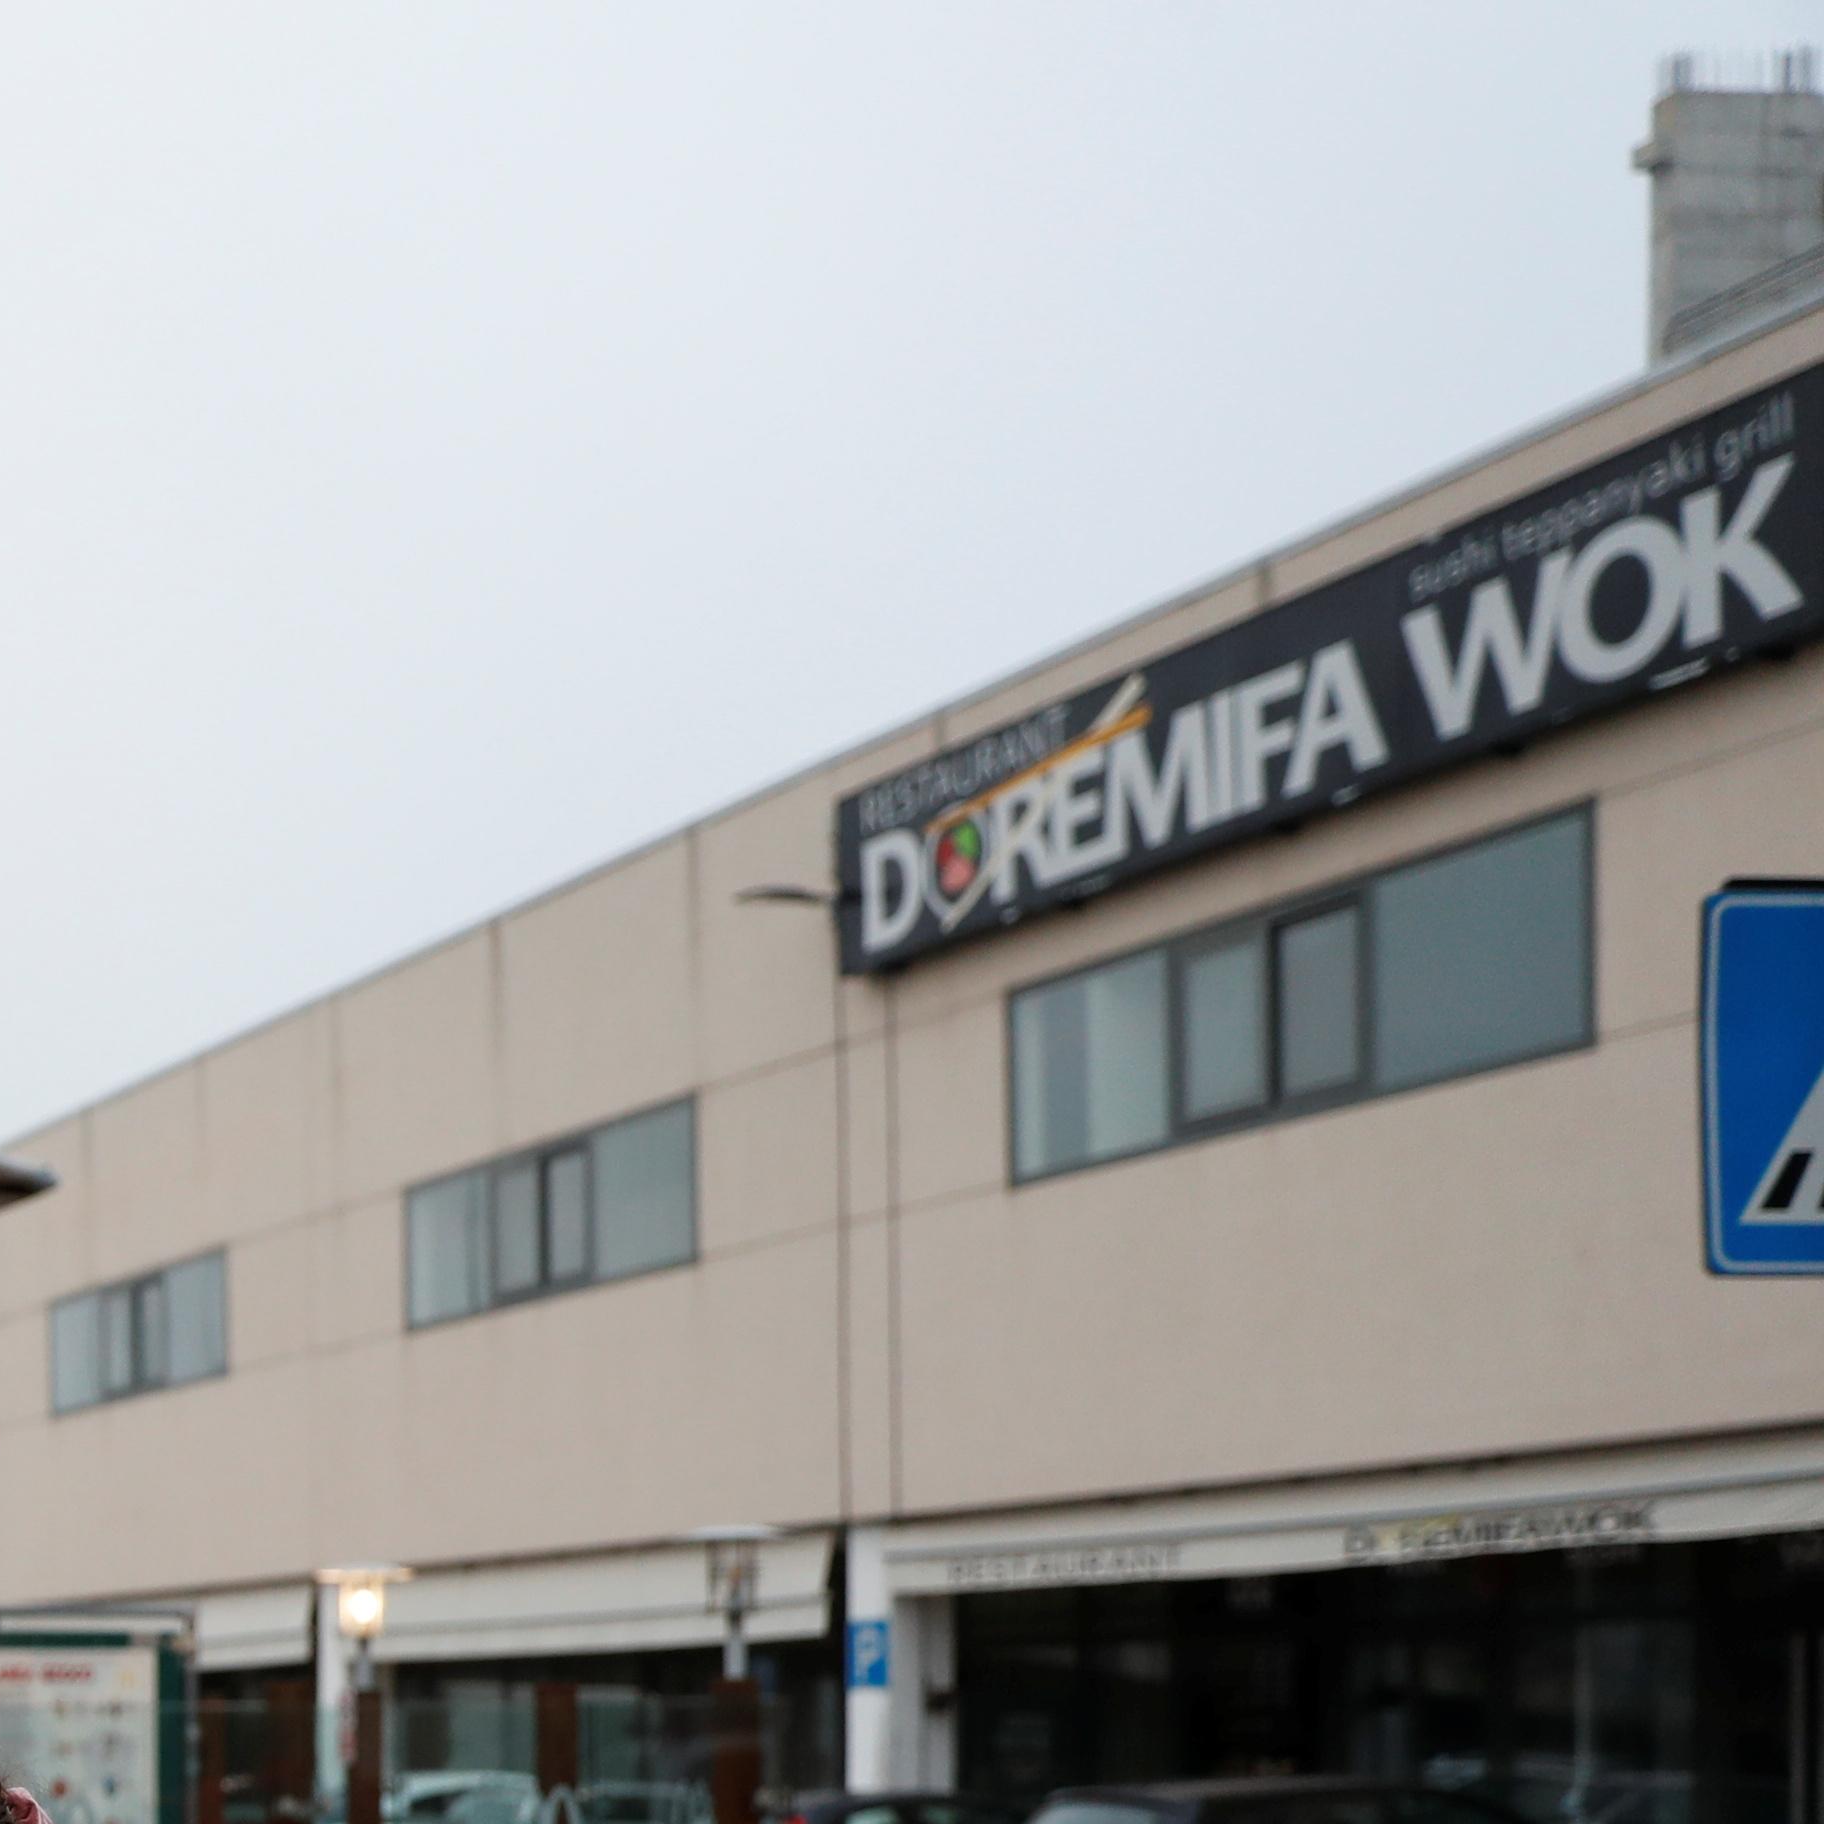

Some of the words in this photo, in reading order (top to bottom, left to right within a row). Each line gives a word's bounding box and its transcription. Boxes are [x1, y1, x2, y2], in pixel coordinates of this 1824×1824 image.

[1713, 391, 1795, 485] grill
[1401, 452, 1805, 742] WOK
[859, 703, 1067, 833] RESTAURANT
